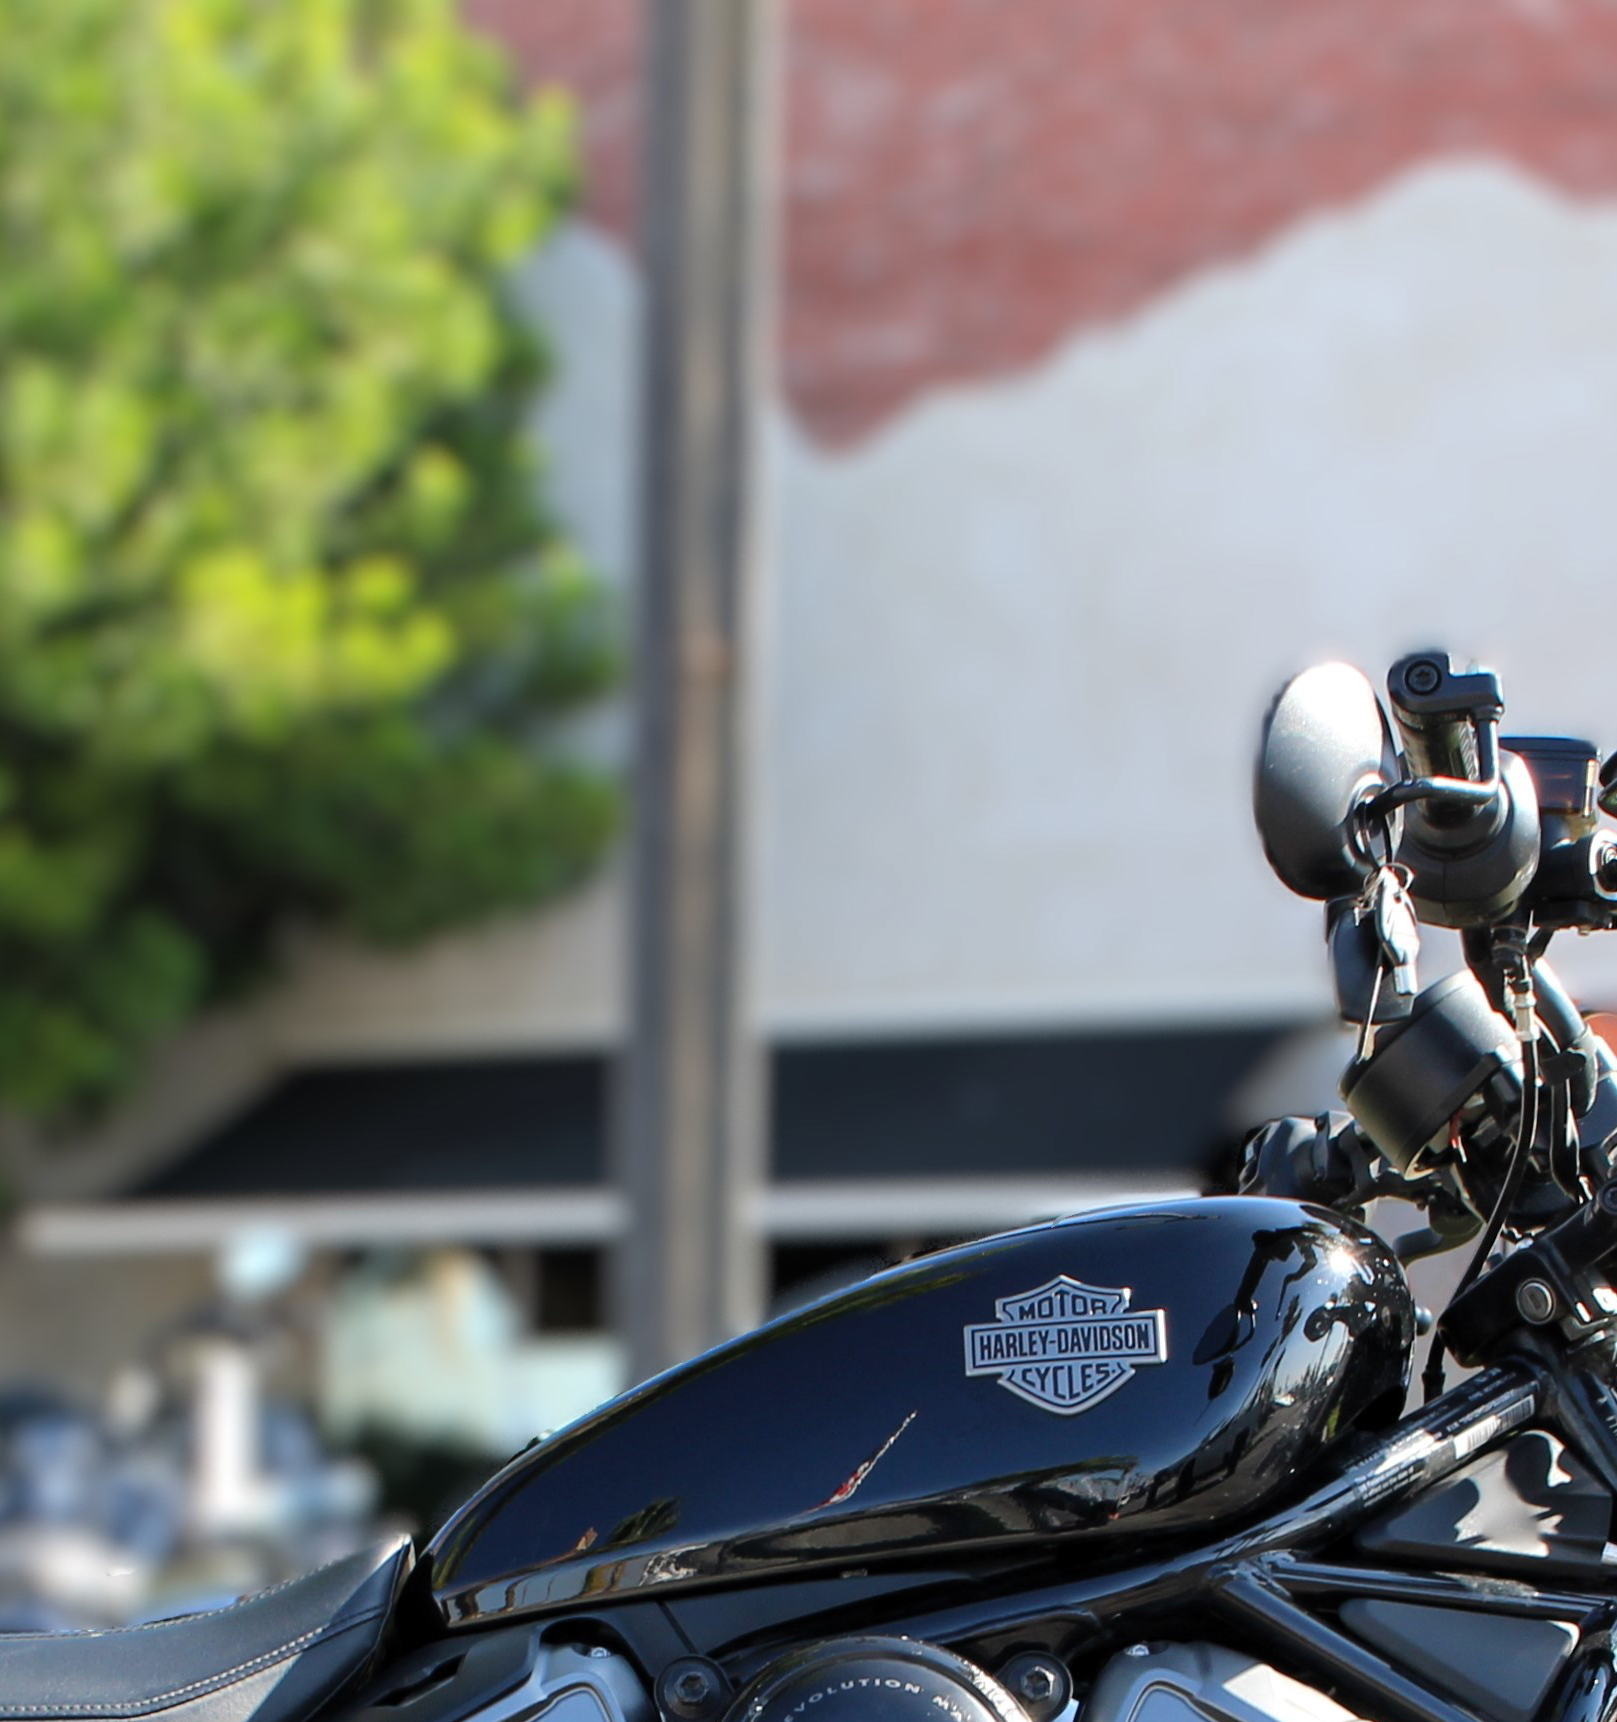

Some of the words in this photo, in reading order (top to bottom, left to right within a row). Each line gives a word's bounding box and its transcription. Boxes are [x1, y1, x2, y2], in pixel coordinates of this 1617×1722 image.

[1019, 1290, 1107, 1321] MOTOR
[979, 1323, 1149, 1361] HARLEY-DAVIDSON
[1021, 1362, 1111, 1400] CYCLES
